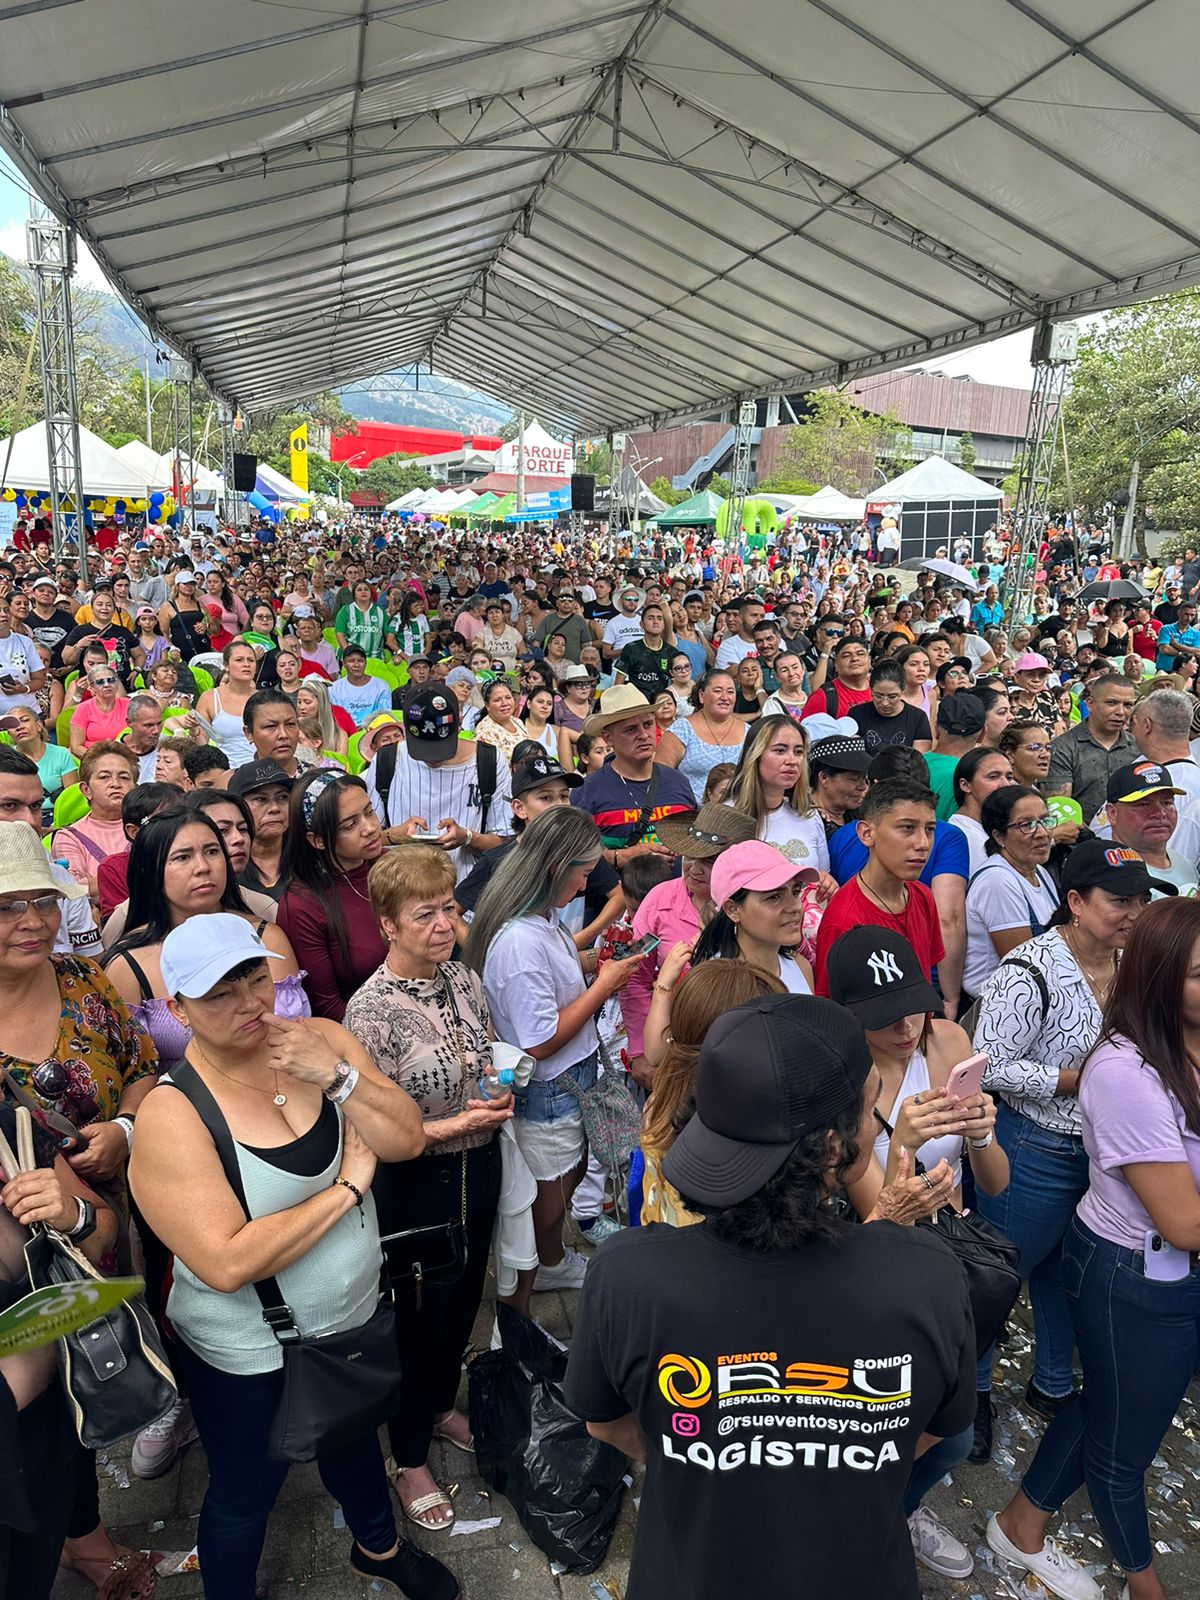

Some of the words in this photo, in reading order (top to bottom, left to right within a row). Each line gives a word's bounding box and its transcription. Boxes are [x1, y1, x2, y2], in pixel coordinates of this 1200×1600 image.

[511, 445, 571, 460] PARQUE
[526, 458, 565, 473] ORTE
[618, 627, 640, 635] adidas
[623, 804, 672, 823] MSIC
[866, 949, 904, 986] NY
[717, 1352, 778, 1366] EVENTOS
[853, 1354, 912, 1370] SONIDO
[718, 1394, 781, 1409] RESPALDO
[784, 1395, 793, 1404] Y
[795, 1395, 864, 1410] SERVICIOS
[866, 1397, 911, 1412] ÚNICOS
[717, 1413, 910, 1436] @rsueventosysonido
[661, 1434, 900, 1471] LOGÍSTICA
